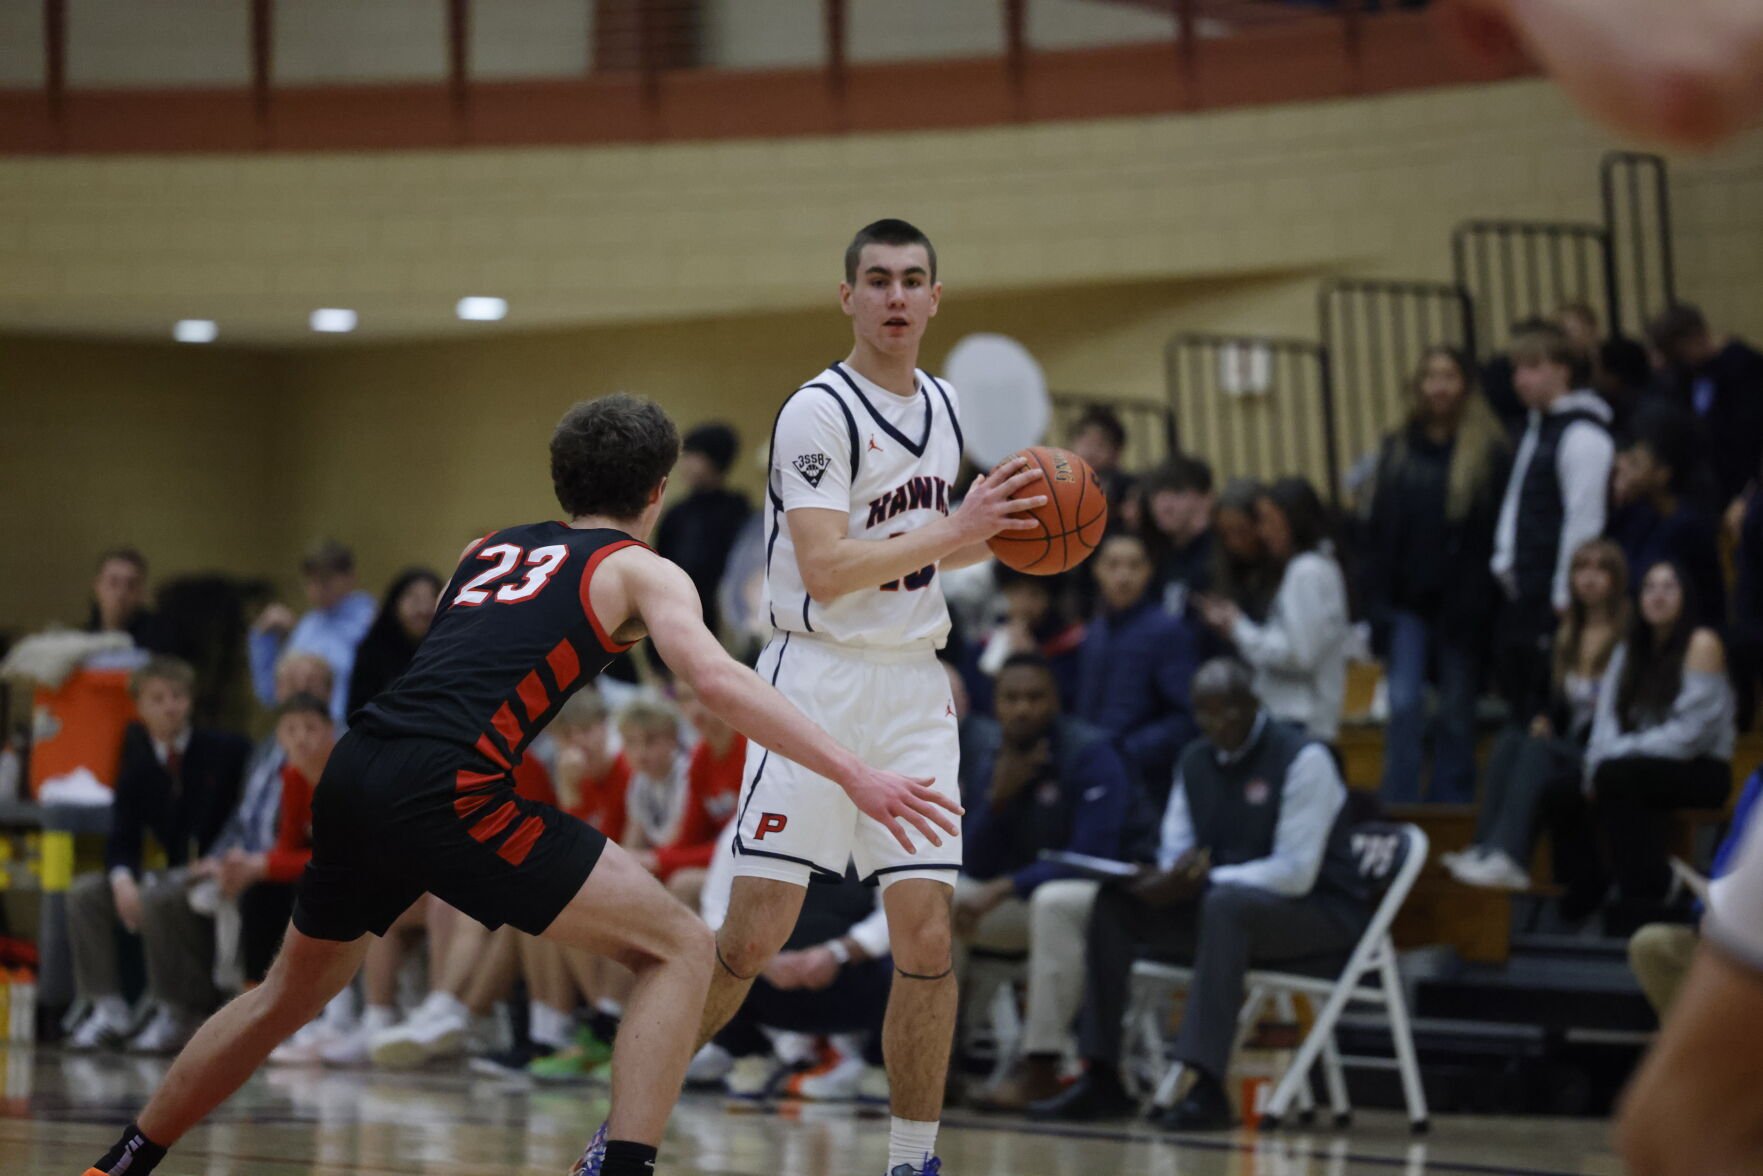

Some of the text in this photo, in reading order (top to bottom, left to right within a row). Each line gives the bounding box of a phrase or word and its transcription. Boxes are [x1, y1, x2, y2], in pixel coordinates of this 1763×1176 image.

[798, 453, 824, 468] 3SSB
[865, 476, 952, 530] HAWK
[449, 543, 570, 608] 23
[753, 811, 788, 840] P
